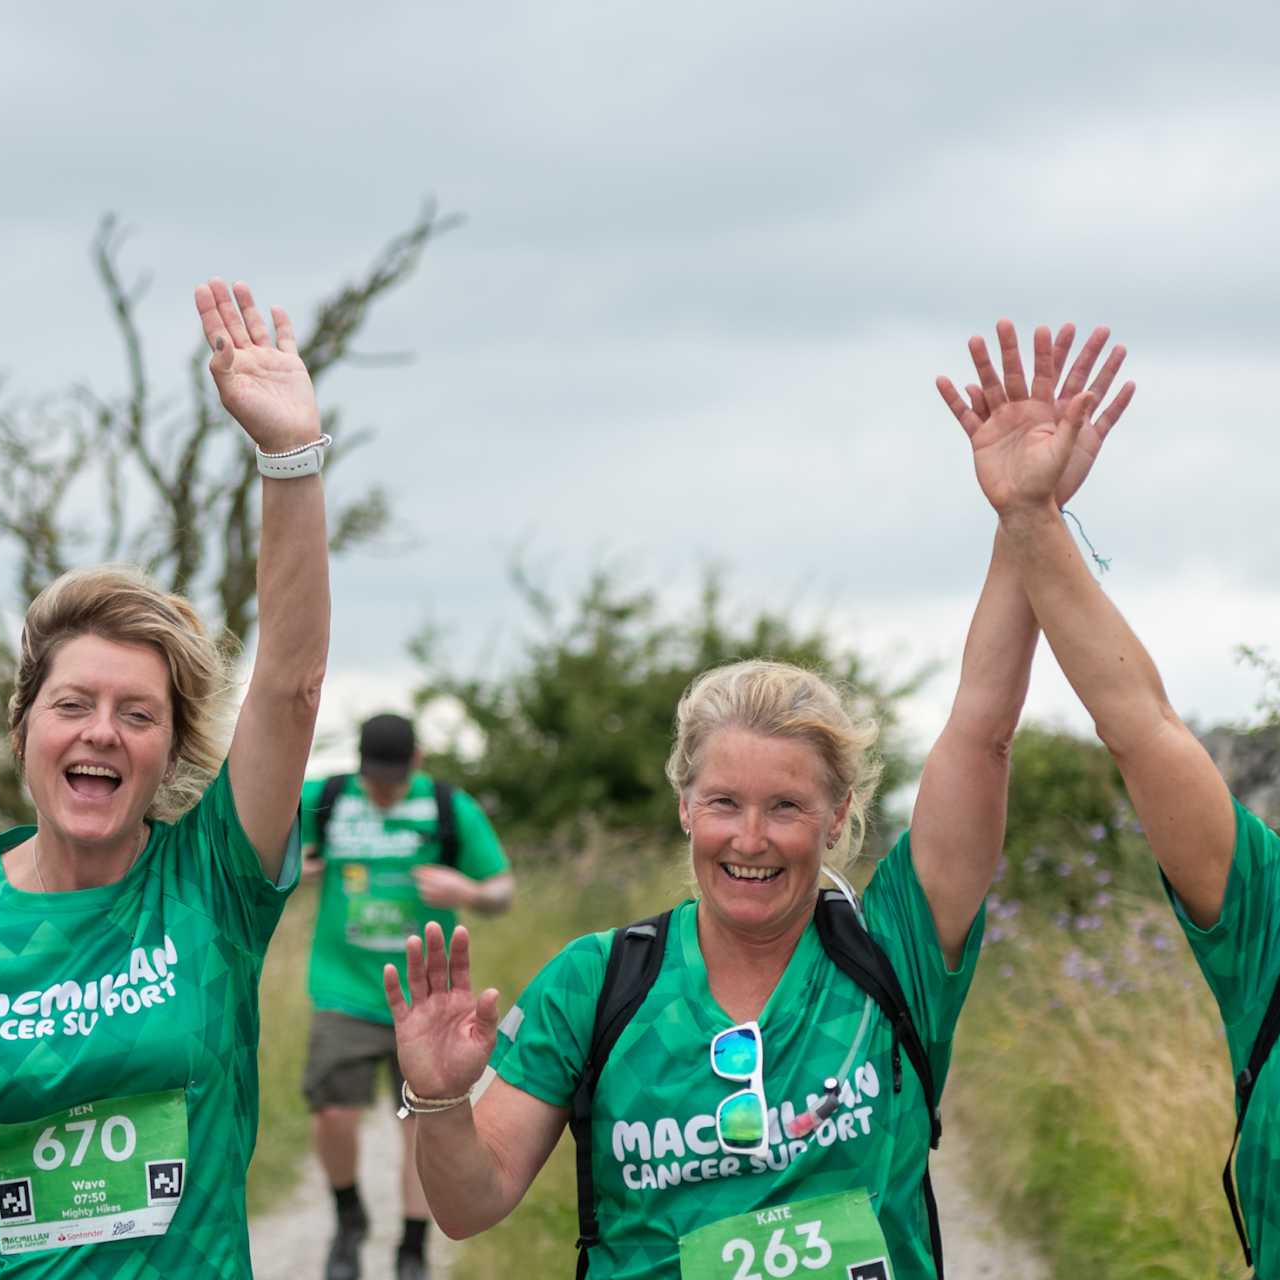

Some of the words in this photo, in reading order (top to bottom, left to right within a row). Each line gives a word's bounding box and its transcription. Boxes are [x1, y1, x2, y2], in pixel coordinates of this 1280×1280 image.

[68, 1104, 93, 1117] JEN
[32, 1115, 137, 1171] 670
[622, 1155, 741, 1190] CANCER
[72, 1179, 106, 1191] Wave
[74, 1191, 106, 1205] 07:50
[62, 1207, 94, 1218] Mighty
[756, 1206, 792, 1225] KATE
